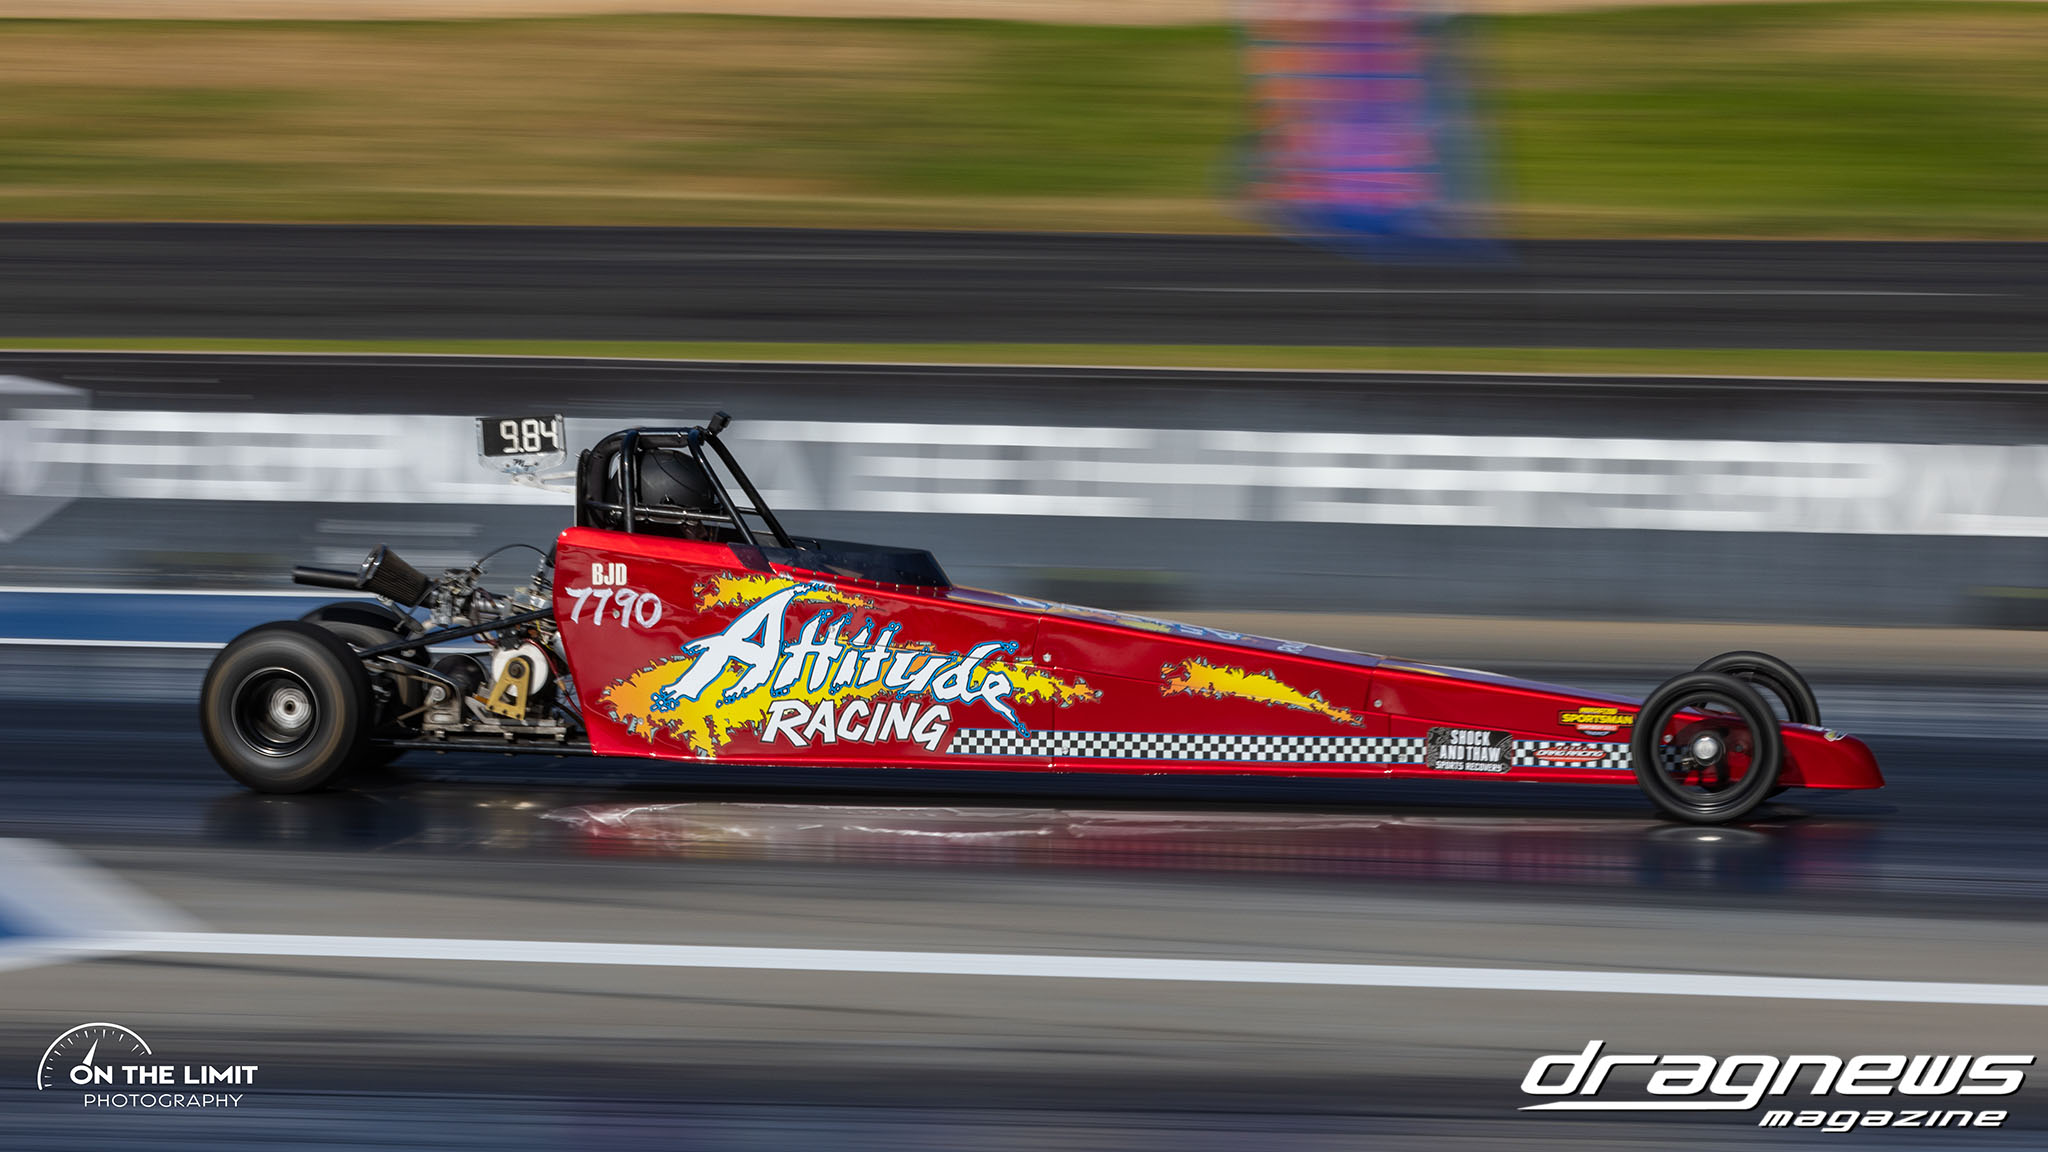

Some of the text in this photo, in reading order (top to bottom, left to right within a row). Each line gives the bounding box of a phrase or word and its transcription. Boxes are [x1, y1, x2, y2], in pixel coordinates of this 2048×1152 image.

[500, 418, 559, 454] 9.84
[592, 563, 627, 586] BJD
[761, 698, 953, 752] RACING
[1561, 712, 1634, 725] SPORTSMAN
[1450, 729, 1491, 746] SHOCK
[1439, 744, 1501, 762] AND THAW
[1435, 760, 1464, 770] SPORTS
